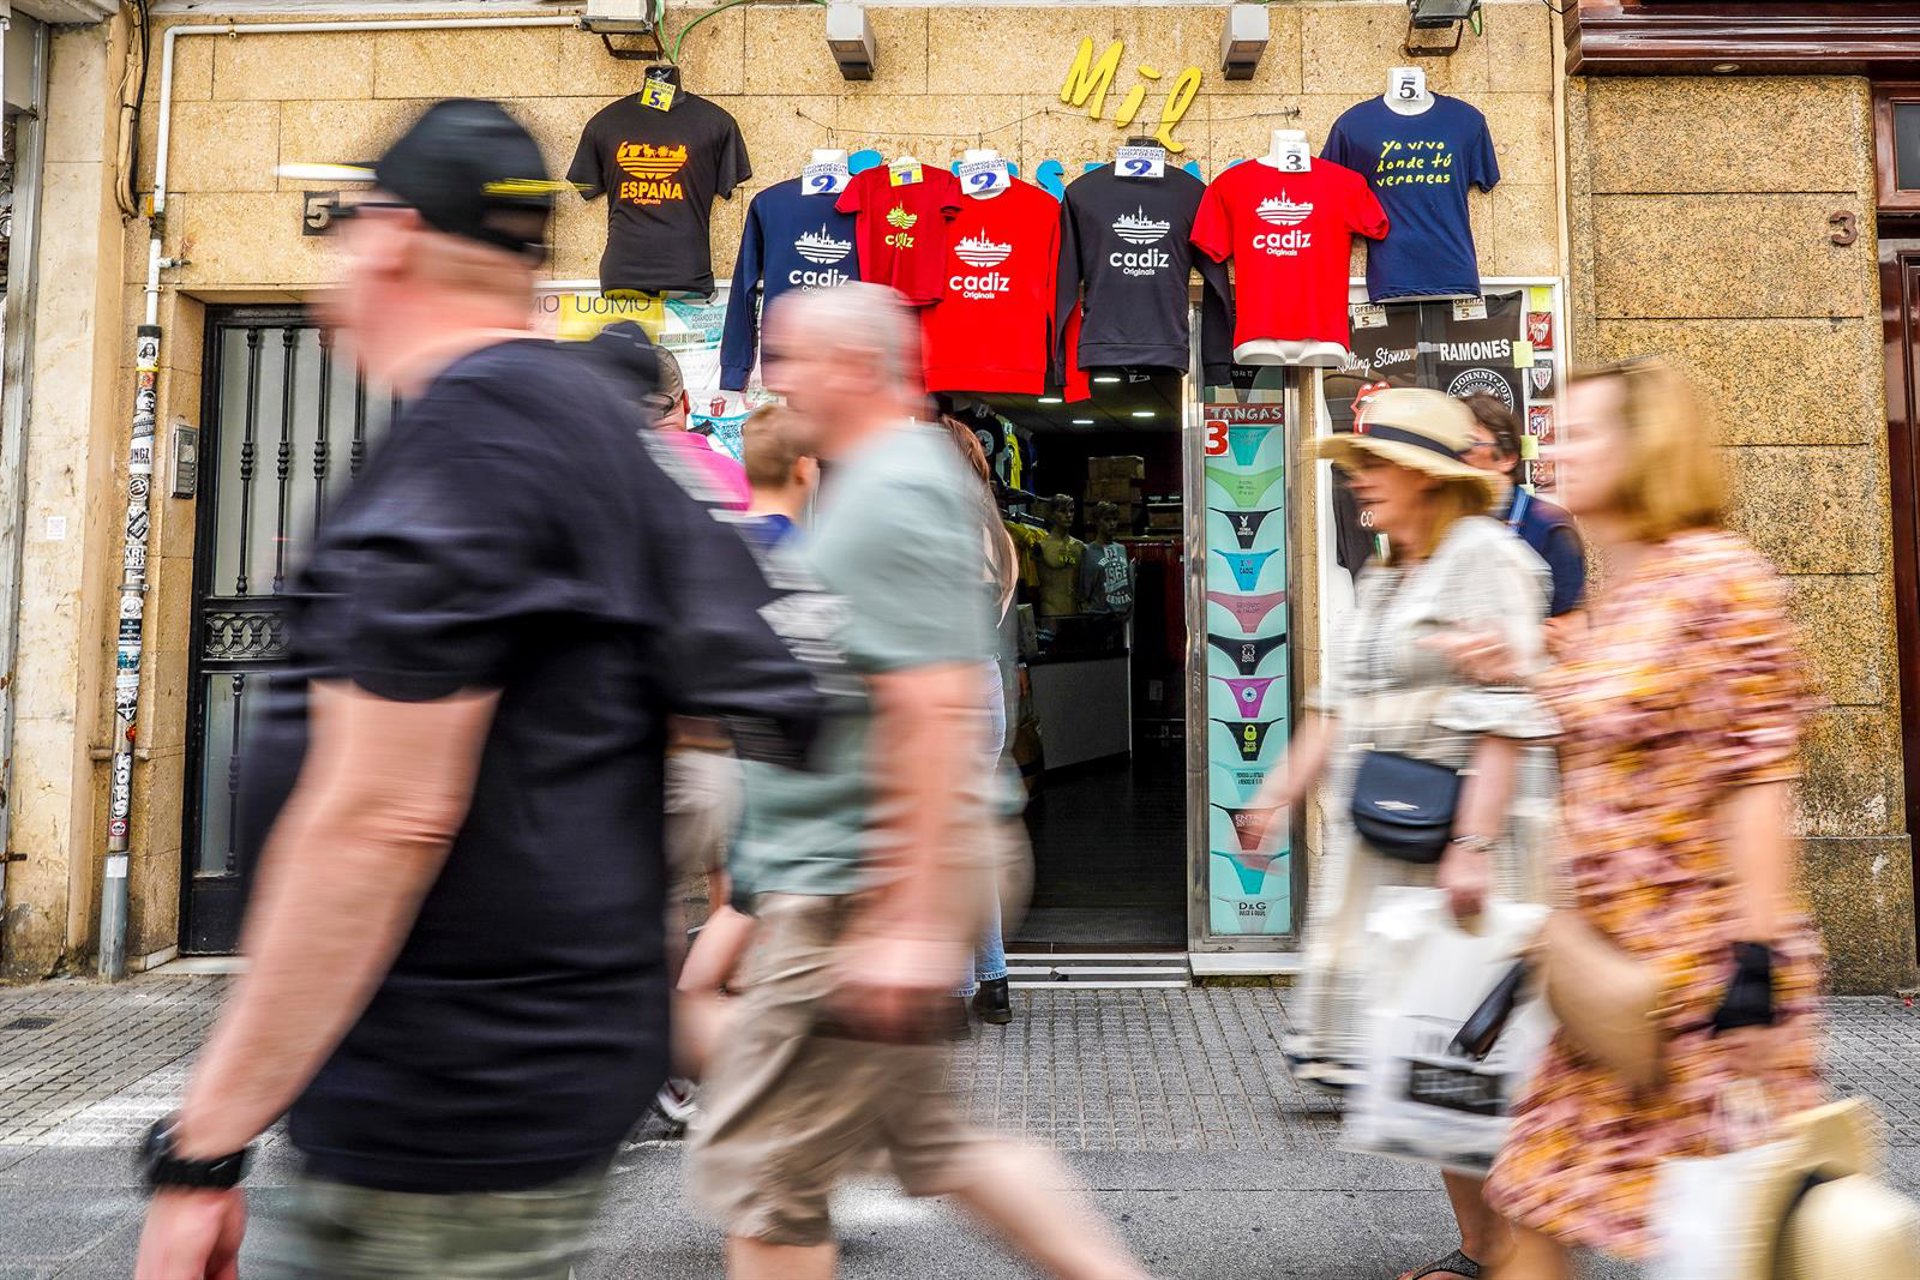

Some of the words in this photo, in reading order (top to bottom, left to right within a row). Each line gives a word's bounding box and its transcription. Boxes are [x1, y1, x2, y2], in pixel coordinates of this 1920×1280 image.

[1061, 36, 1202, 153] Mil
[1407, 141, 1445, 150] vivo
[1124, 158, 1153, 176] 9
[1377, 156, 1424, 173] donde
[1431, 152, 1453, 168] tú
[620, 180, 684, 200] ESPAÑA
[970, 171, 998, 192] 9
[1376, 173, 1451, 187] veraneas
[306, 197, 331, 229] 5
[1829, 210, 1858, 246] 3
[1253, 229, 1312, 249] cadiz
[1109, 248, 1170, 268] cadiz
[1266, 247, 1298, 257] Originals
[788, 268, 850, 287] cadiz
[949, 271, 1011, 292] cadiz
[1122, 267, 1156, 277] Originals
[576, 294, 651, 314] UOMO
[962, 290, 995, 300] Originals
[1361, 316, 1370, 327] 5
[1462, 308, 1470, 319] 5
[1374, 347, 1411, 368] Stones
[1440, 339, 1511, 361] RAMONES
[1454, 371, 1496, 391] JOHNNY
[1496, 381, 1512, 407] JOEY
[1210, 407, 1282, 421] TANGAS
[1205, 421, 1229, 455] 3
[1239, 901, 1267, 910] D&G
